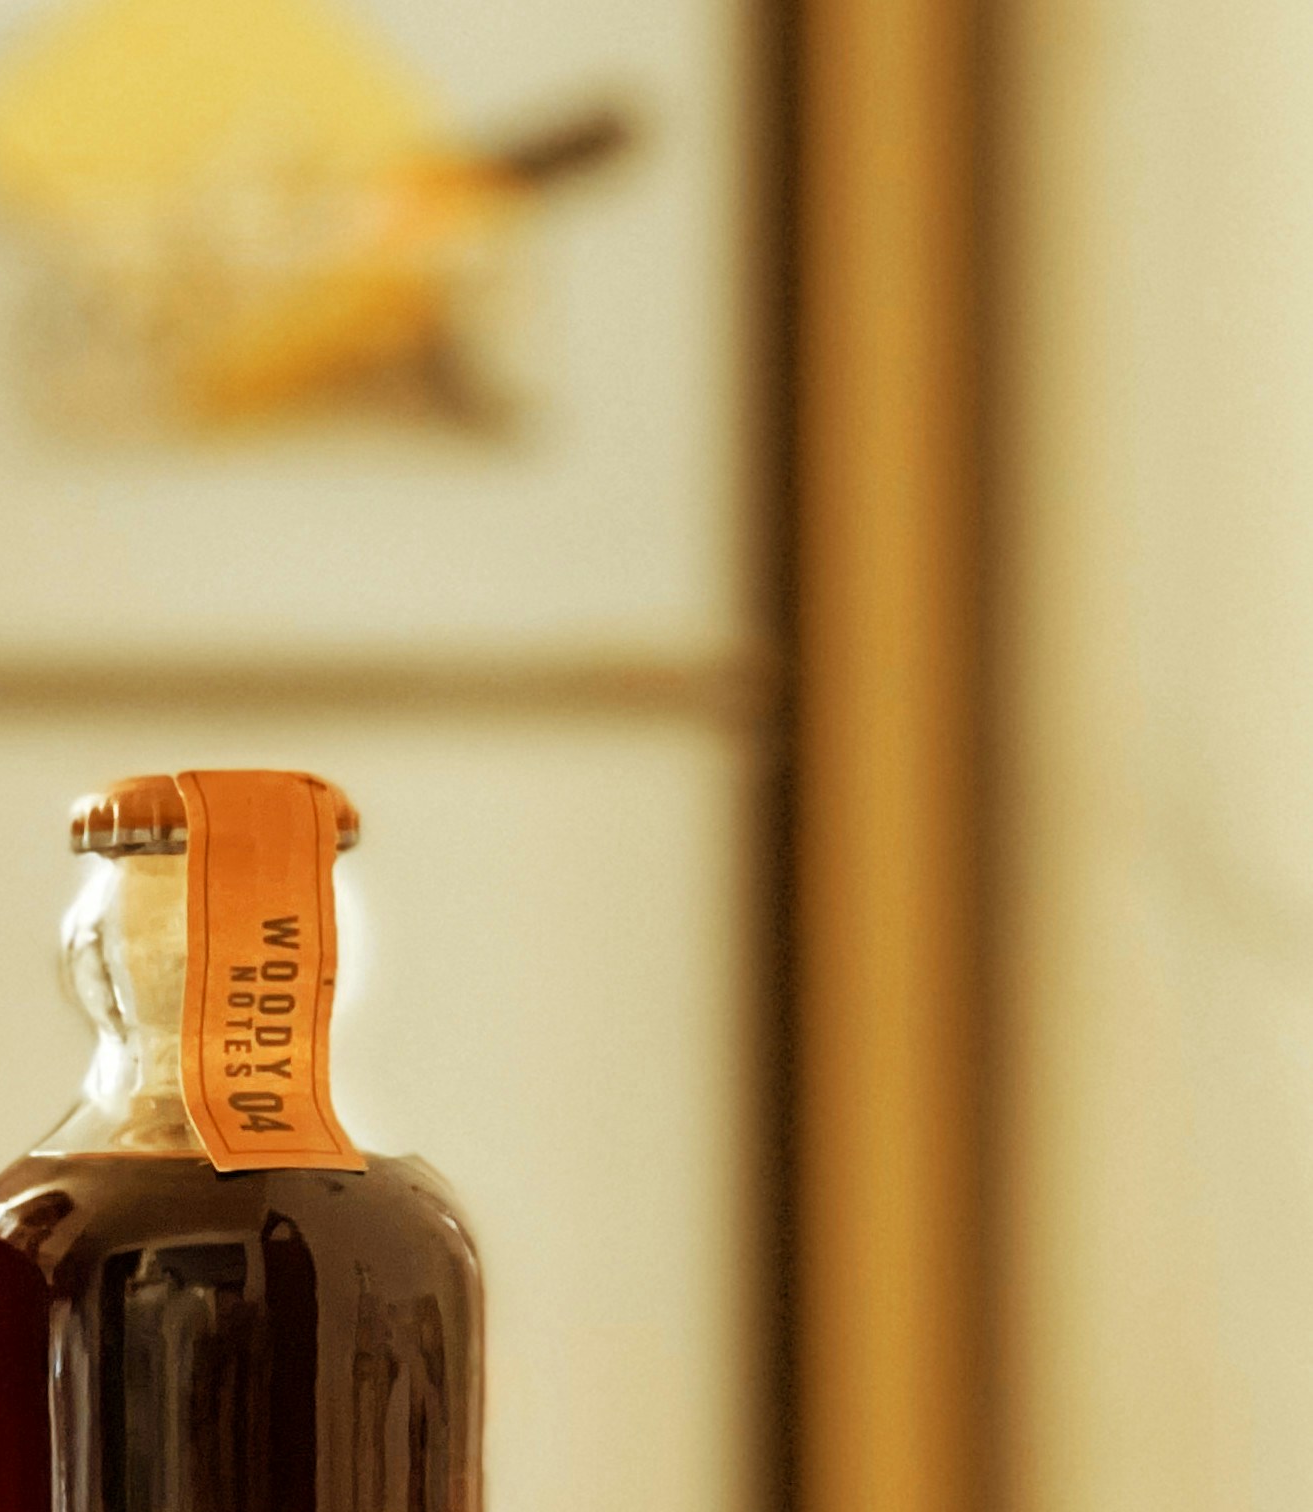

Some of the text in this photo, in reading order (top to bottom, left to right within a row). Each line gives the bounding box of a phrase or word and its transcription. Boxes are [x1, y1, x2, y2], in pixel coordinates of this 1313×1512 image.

[224, 965, 258, 1080] NOTES
[254, 915, 301, 1080] WOODY
[228, 1091, 294, 1134] 04
